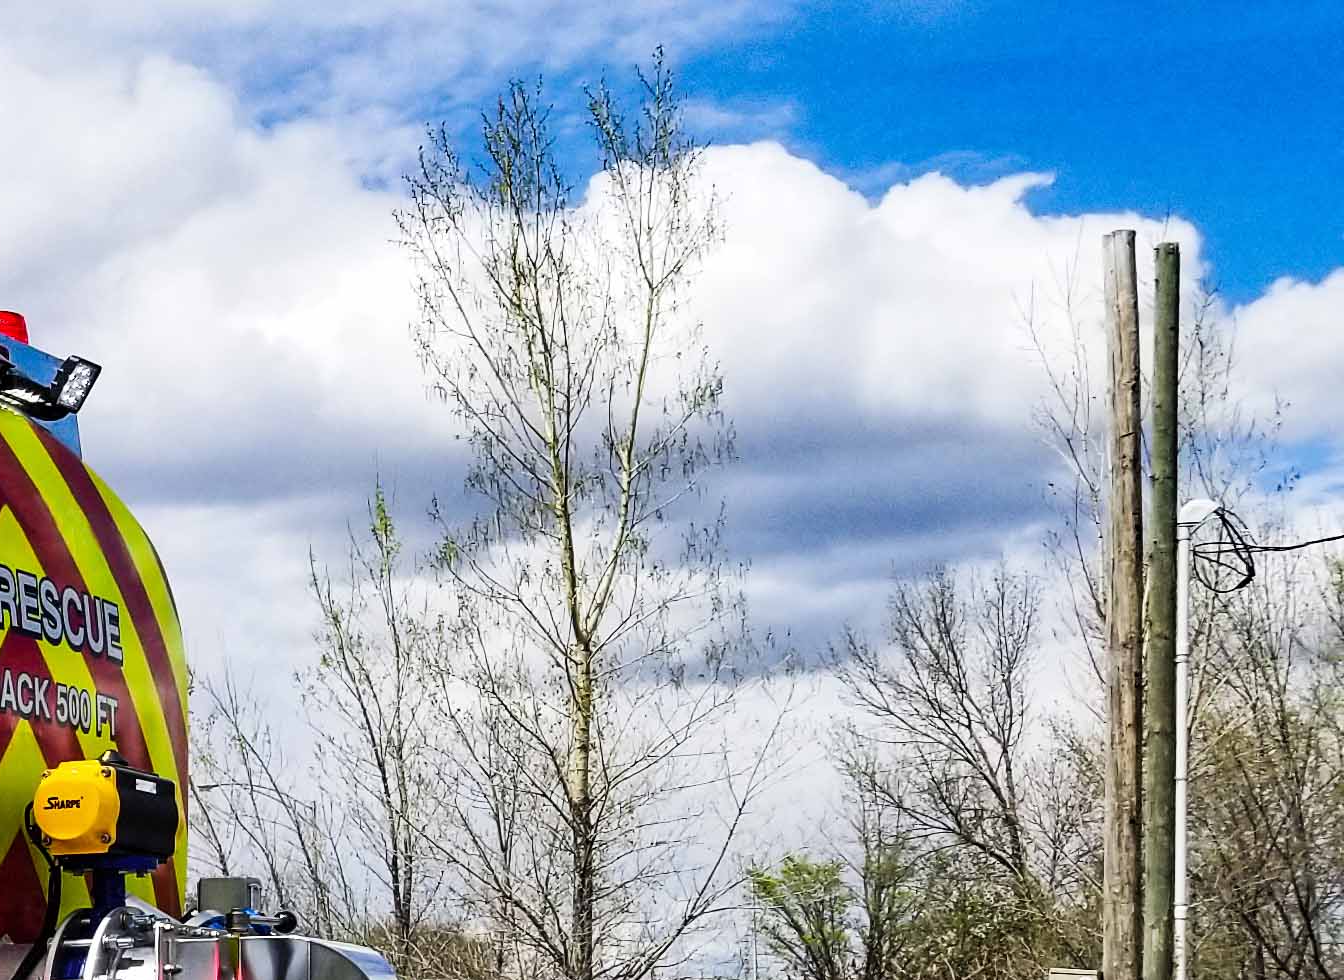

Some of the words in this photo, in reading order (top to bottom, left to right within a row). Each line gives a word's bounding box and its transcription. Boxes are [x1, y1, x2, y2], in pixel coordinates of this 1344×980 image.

[56, 683, 92, 732] 500
[95, 692, 119, 738] FT
[43, 796, 81, 810] SHARPE
